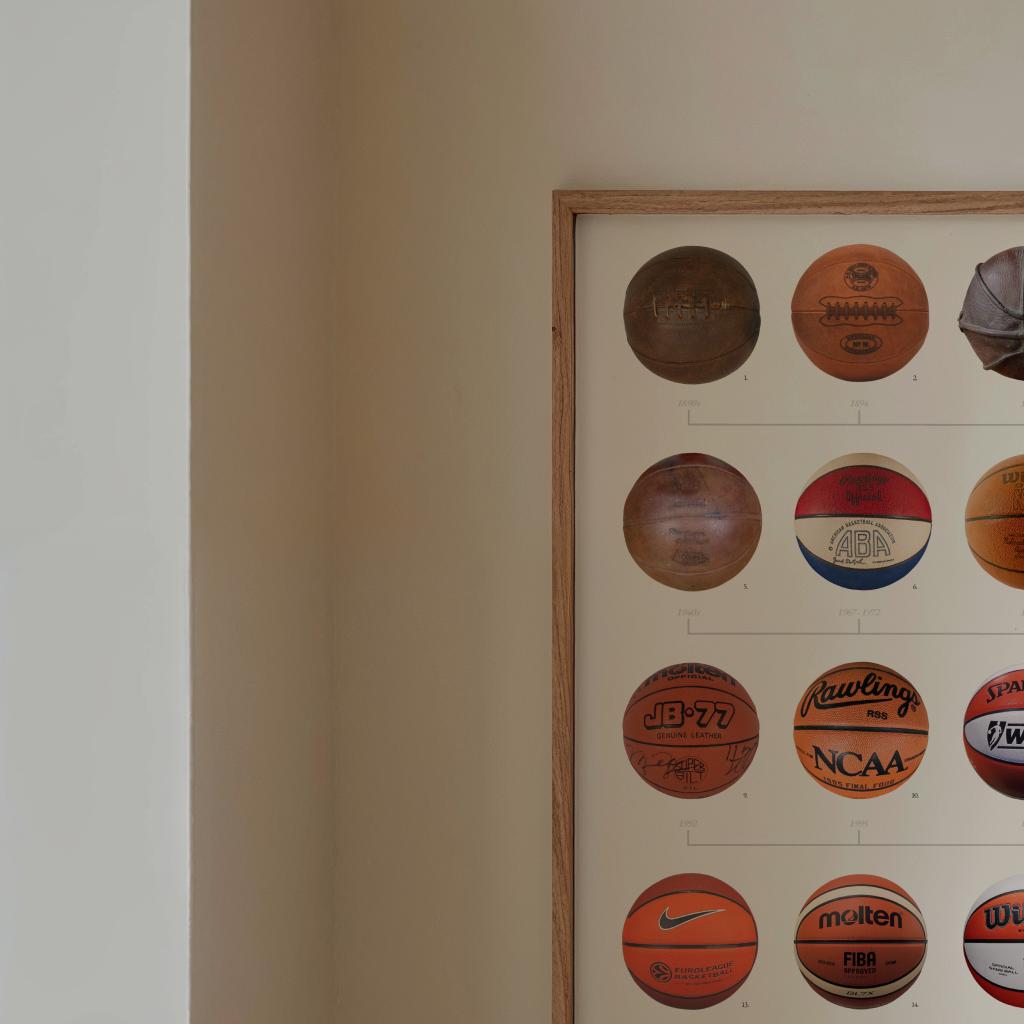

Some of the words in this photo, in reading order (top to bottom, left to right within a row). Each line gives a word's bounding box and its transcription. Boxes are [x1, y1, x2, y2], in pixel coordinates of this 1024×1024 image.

[835, 530, 891, 557] ABA
[800, 672, 920, 718] Rawlings
[866, 709, 888, 720] RSS
[656, 731, 687, 739] GENUINE
[691, 732, 722, 740] LEATHER
[812, 745, 908, 777] NCAA
[819, 906, 903, 929] molten
[843, 951, 876, 967] FIBA
[843, 967, 876, 975] APPROVED
